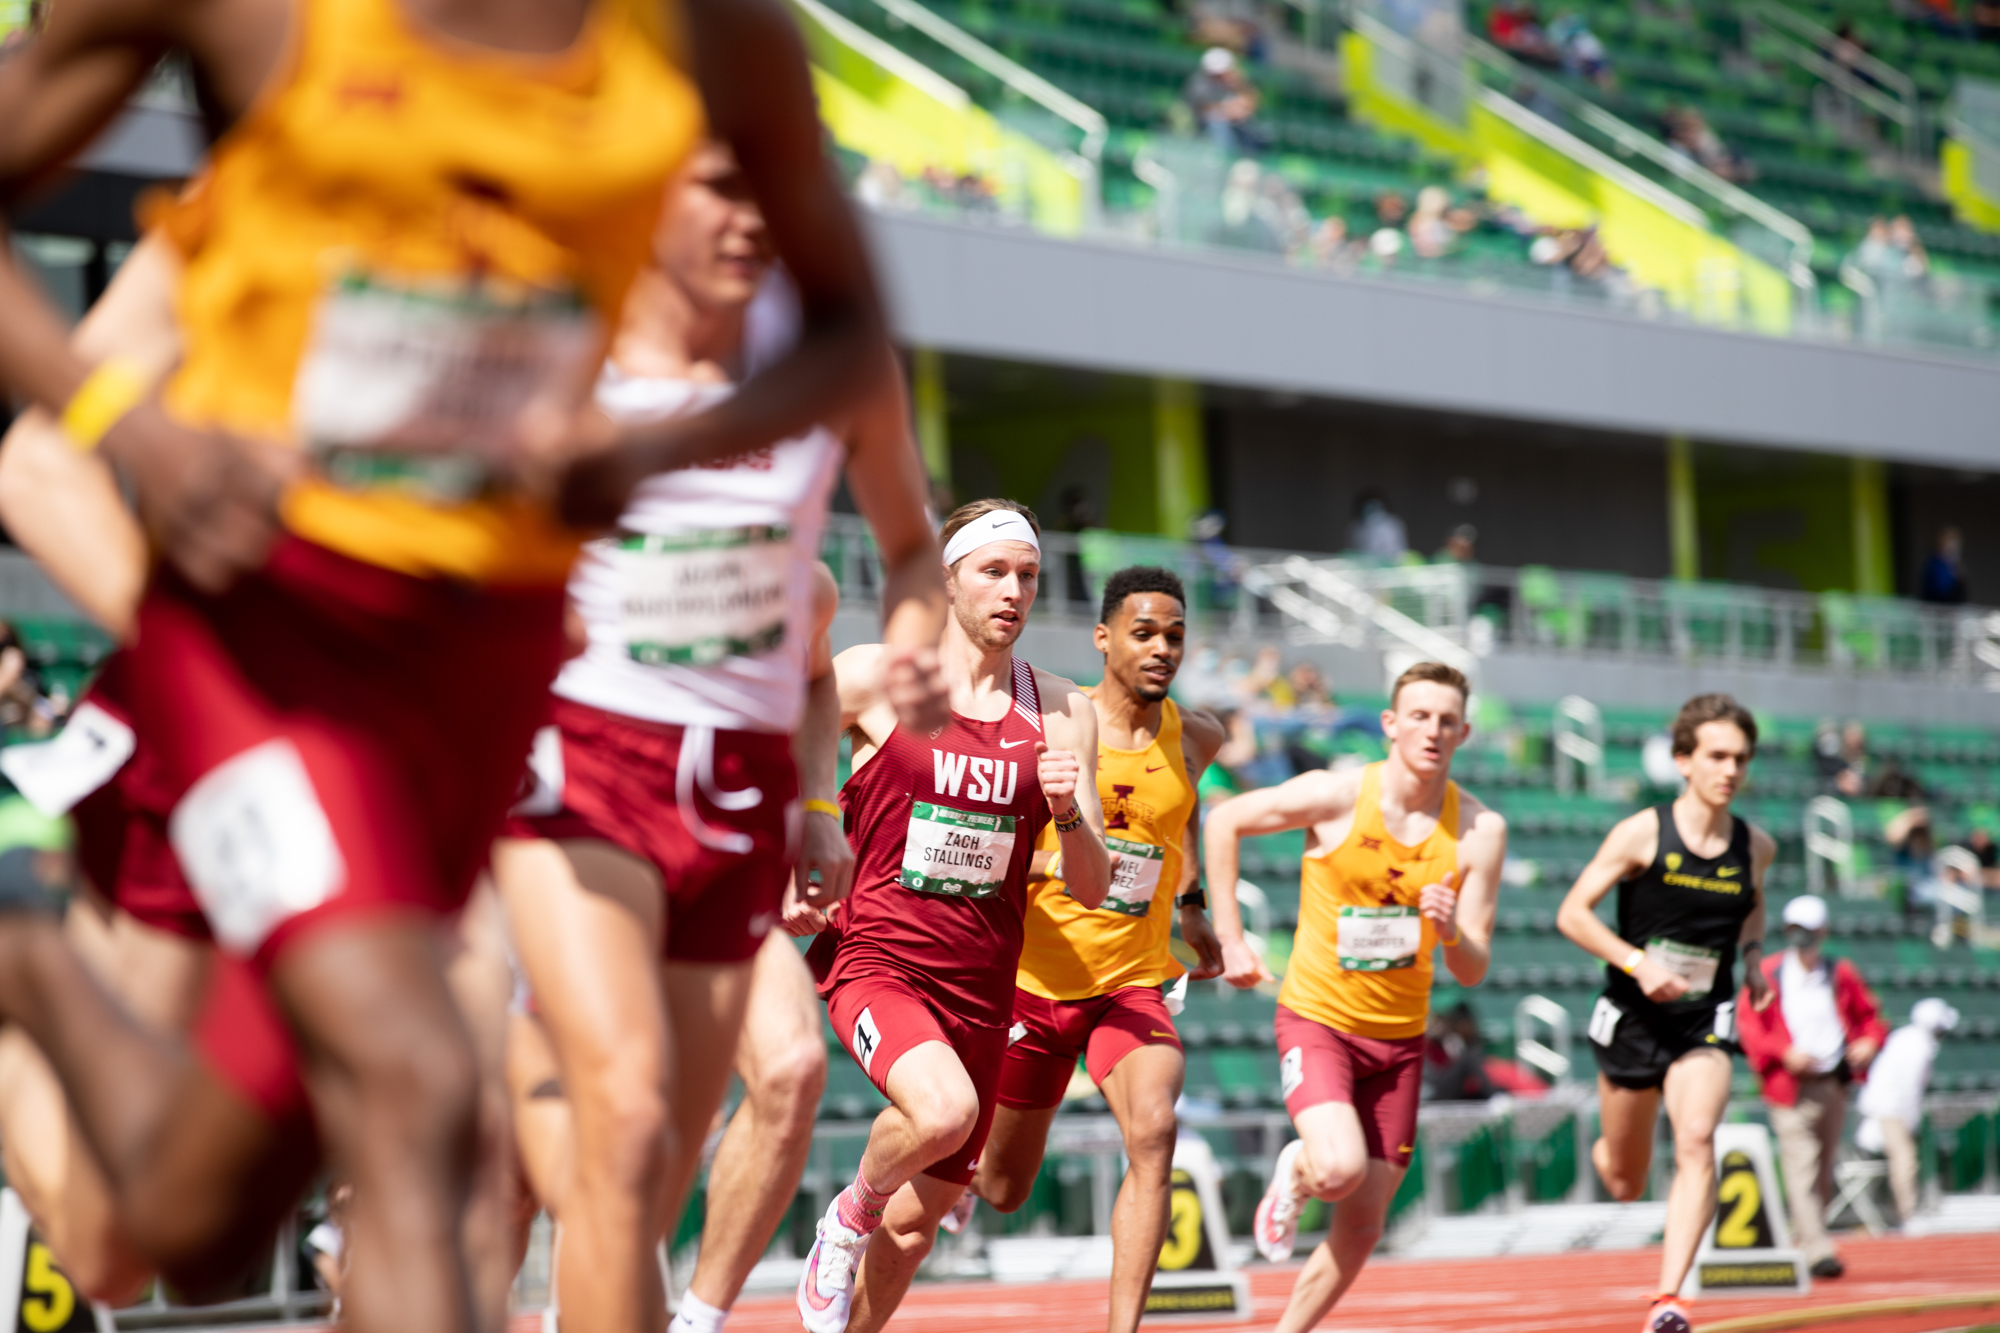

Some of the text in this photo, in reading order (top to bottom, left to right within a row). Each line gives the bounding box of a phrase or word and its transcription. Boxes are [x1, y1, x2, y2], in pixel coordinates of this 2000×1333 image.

[932, 748, 1018, 805] WSU
[924, 847, 993, 870] STALLINGS
[945, 832, 980, 850] ZACH
[1663, 871, 1742, 895] OREGON
[858, 1023, 873, 1065] 4
[1157, 1188, 1201, 1271] 3
[1718, 1171, 1761, 1247] 2
[21, 1242, 75, 1333] 5
